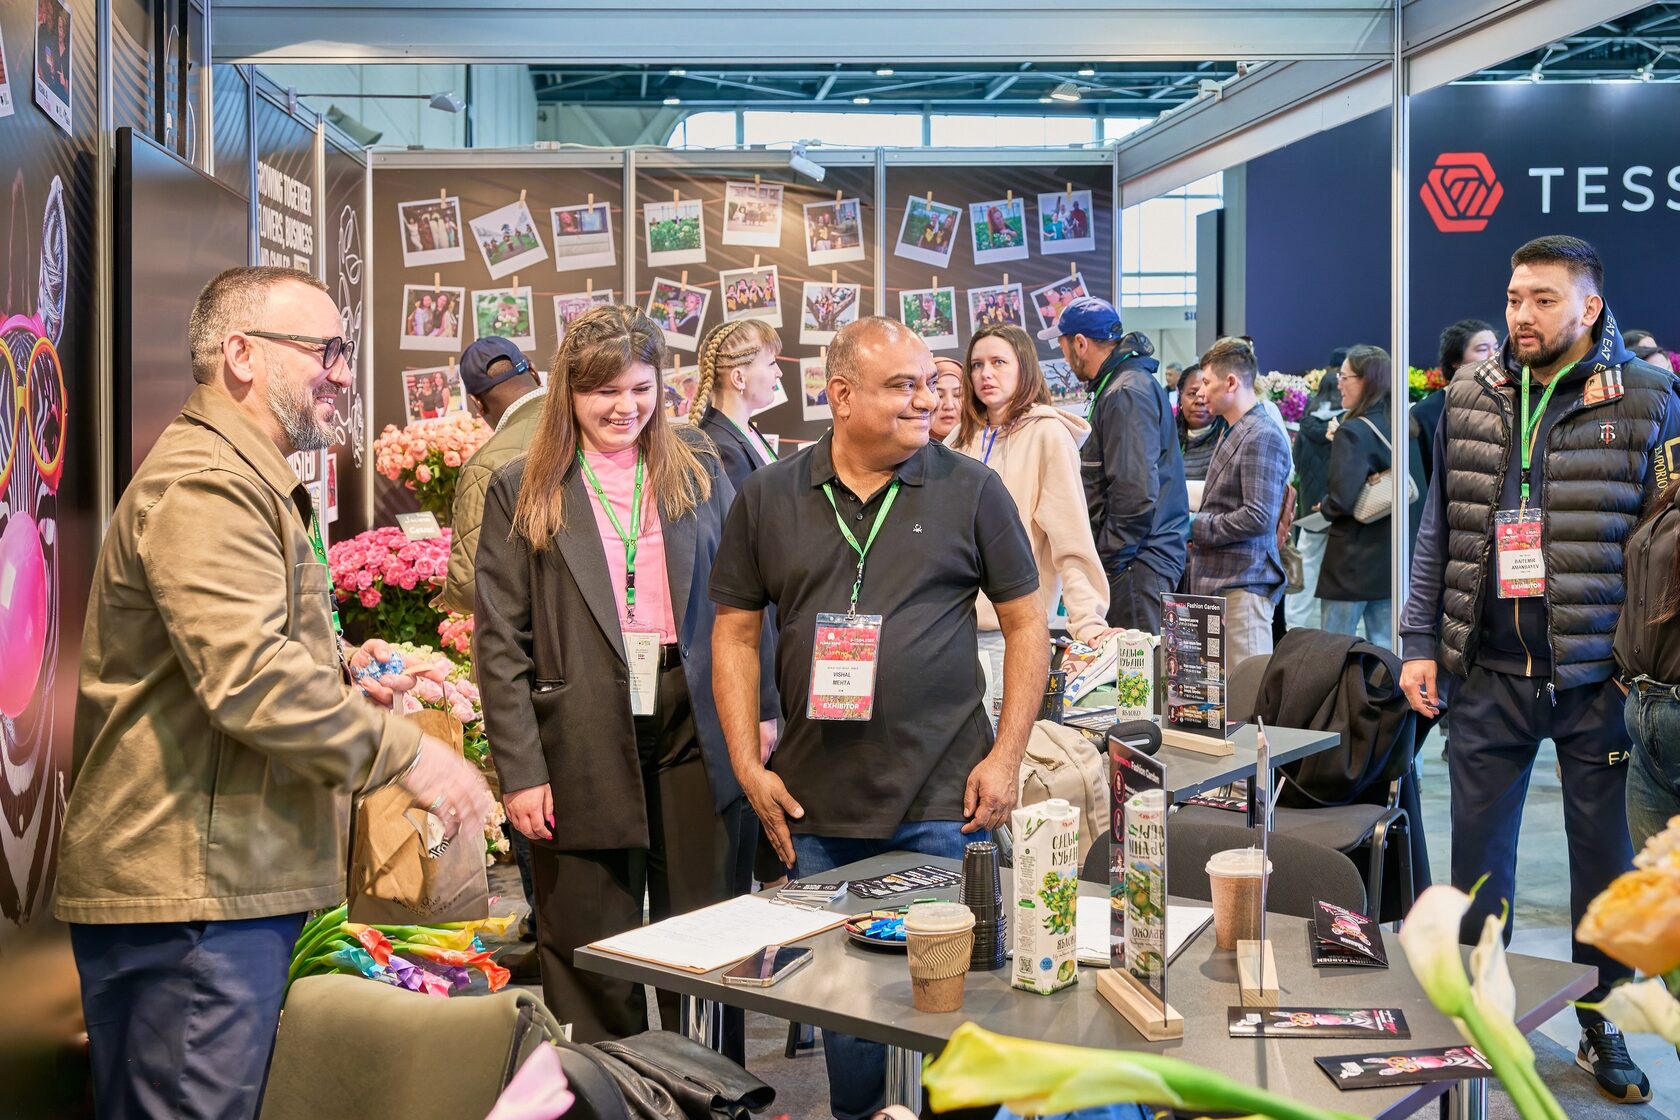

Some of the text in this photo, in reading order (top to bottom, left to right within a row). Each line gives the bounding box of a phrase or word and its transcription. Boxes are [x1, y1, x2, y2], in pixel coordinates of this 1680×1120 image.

[284, 174, 312, 217] TOGETHER
[285, 215, 314, 256] BUSINESS
[1601, 337, 1613, 362] EA7
[1592, 362, 1607, 374] E
[1186, 602, 1203, 610] Fashion
[1203, 603, 1220, 611] Garden
[822, 702, 860, 710] EXHIBITOR
